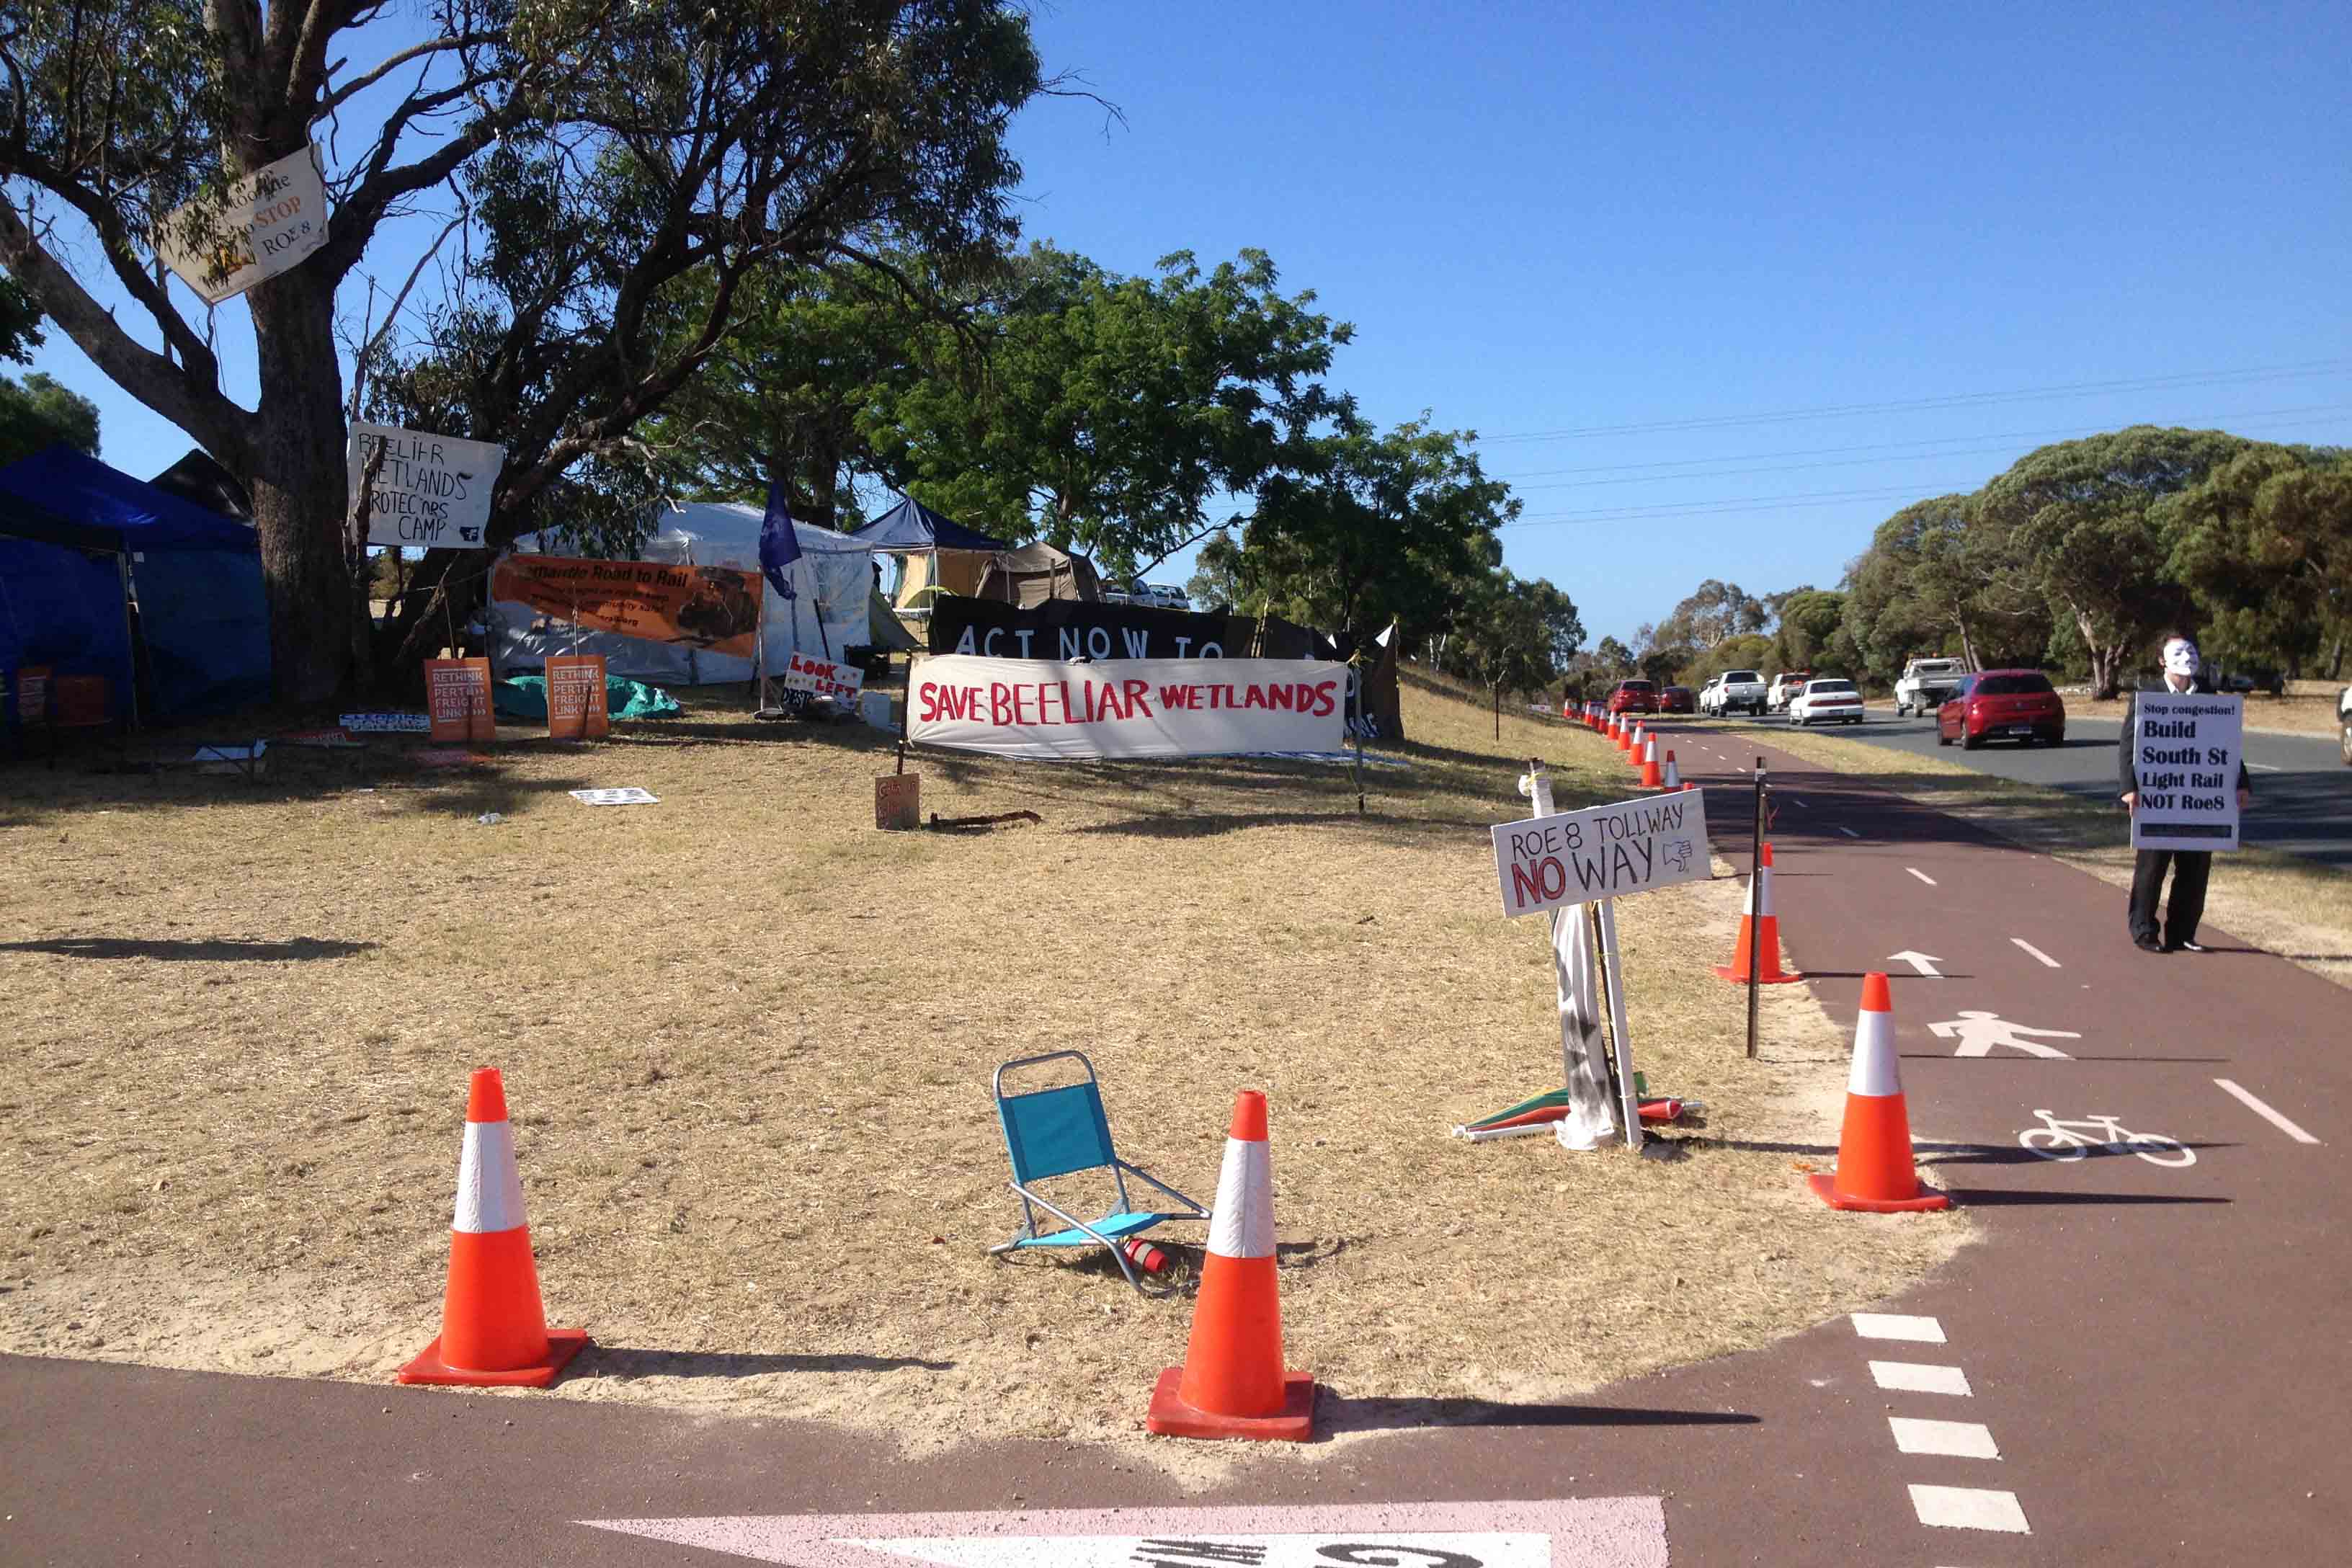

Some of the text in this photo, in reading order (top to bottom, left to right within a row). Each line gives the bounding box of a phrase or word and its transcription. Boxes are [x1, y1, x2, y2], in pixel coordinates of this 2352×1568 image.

[254, 195, 301, 226] STOP
[262, 225, 300, 255] ROE
[300, 219, 312, 235] 8
[398, 516, 447, 541] CAMP
[592, 566, 633, 582] Road
[636, 568, 652, 583] to
[657, 569, 689, 588] Rail
[955, 625, 1224, 662] ACT NOW TO
[432, 671, 484, 682] RETHINK
[553, 669, 600, 680] RETHINK
[790, 655, 839, 682] LOOK
[816, 679, 858, 699] LEFT
[554, 704, 582, 716] LINK
[919, 682, 984, 723] SAVE
[990, 680, 1154, 726] BEELIAR
[1159, 680, 1337, 717] WETLANDS
[2144, 703, 2236, 717] Stop congestion!
[2144, 721, 2196, 739] Build
[2142, 746, 2229, 765] South St
[2142, 772, 2224, 790] Light Rail
[2141, 794, 2225, 811] NOT Roe8
[1511, 803, 1684, 861] ROE 8 TOLLWAY
[1510, 837, 1653, 908] NO WAY
